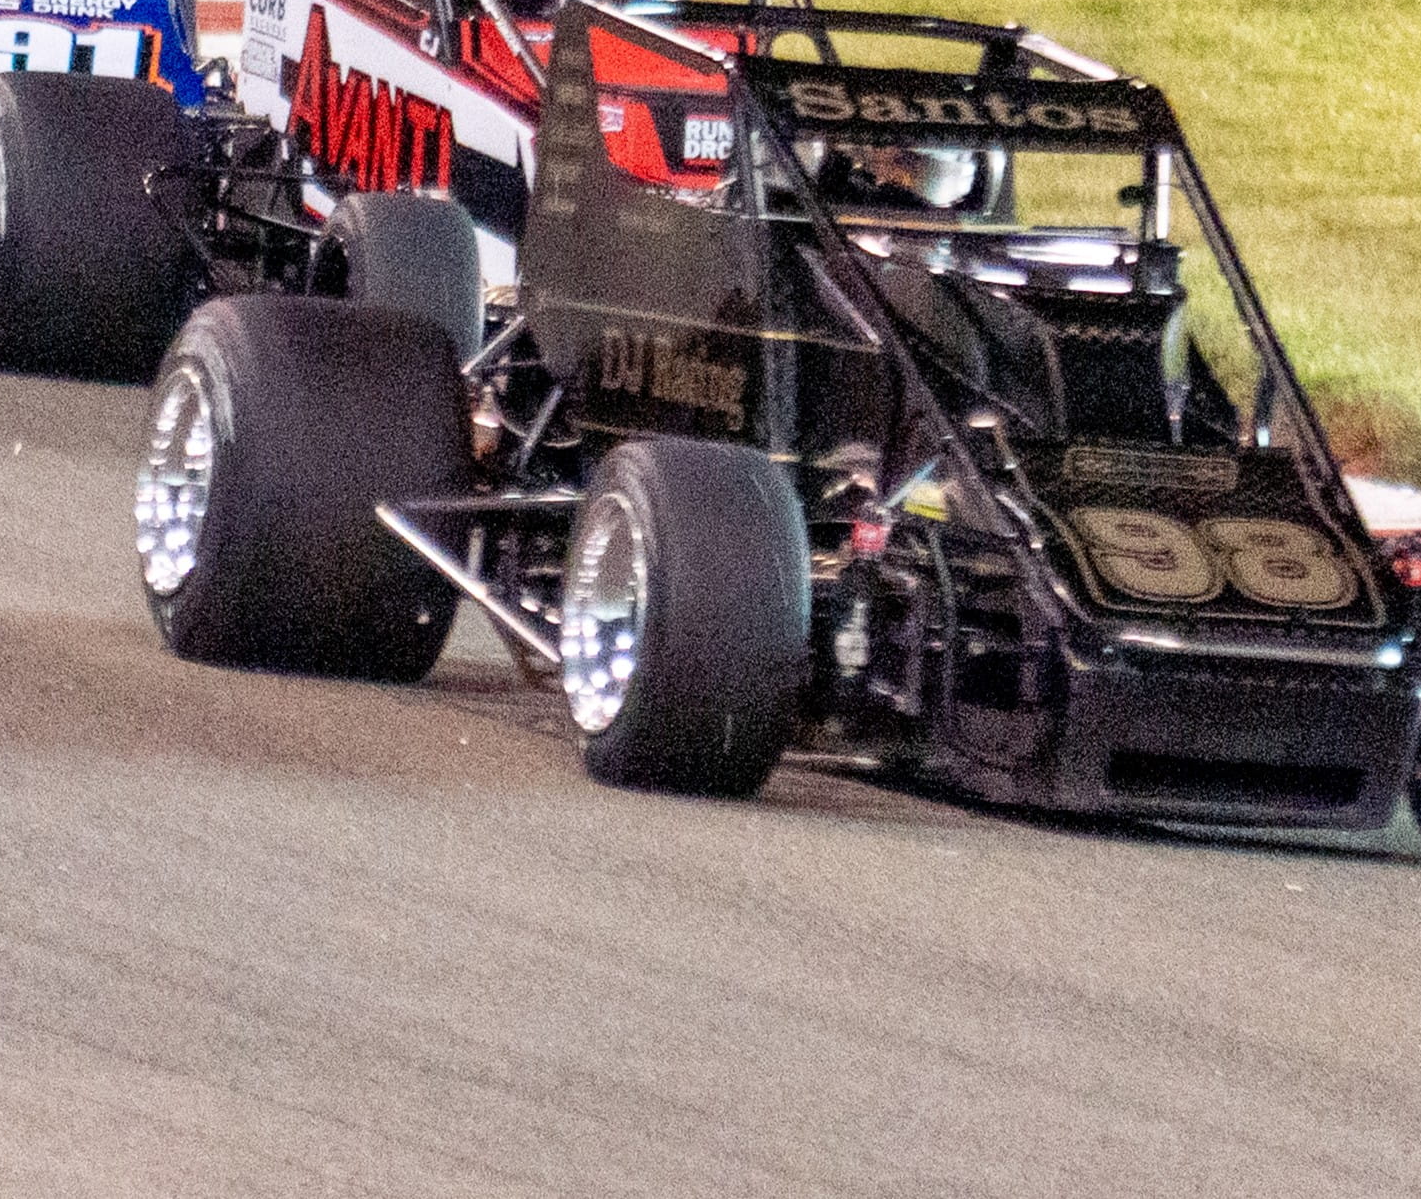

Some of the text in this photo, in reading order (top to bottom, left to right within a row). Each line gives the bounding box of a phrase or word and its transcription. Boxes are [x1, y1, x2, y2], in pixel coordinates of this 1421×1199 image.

[33, 3, 113, 20] DRINK
[789, 79, 1138, 133] Santos
[1069, 506, 1357, 610] 98
